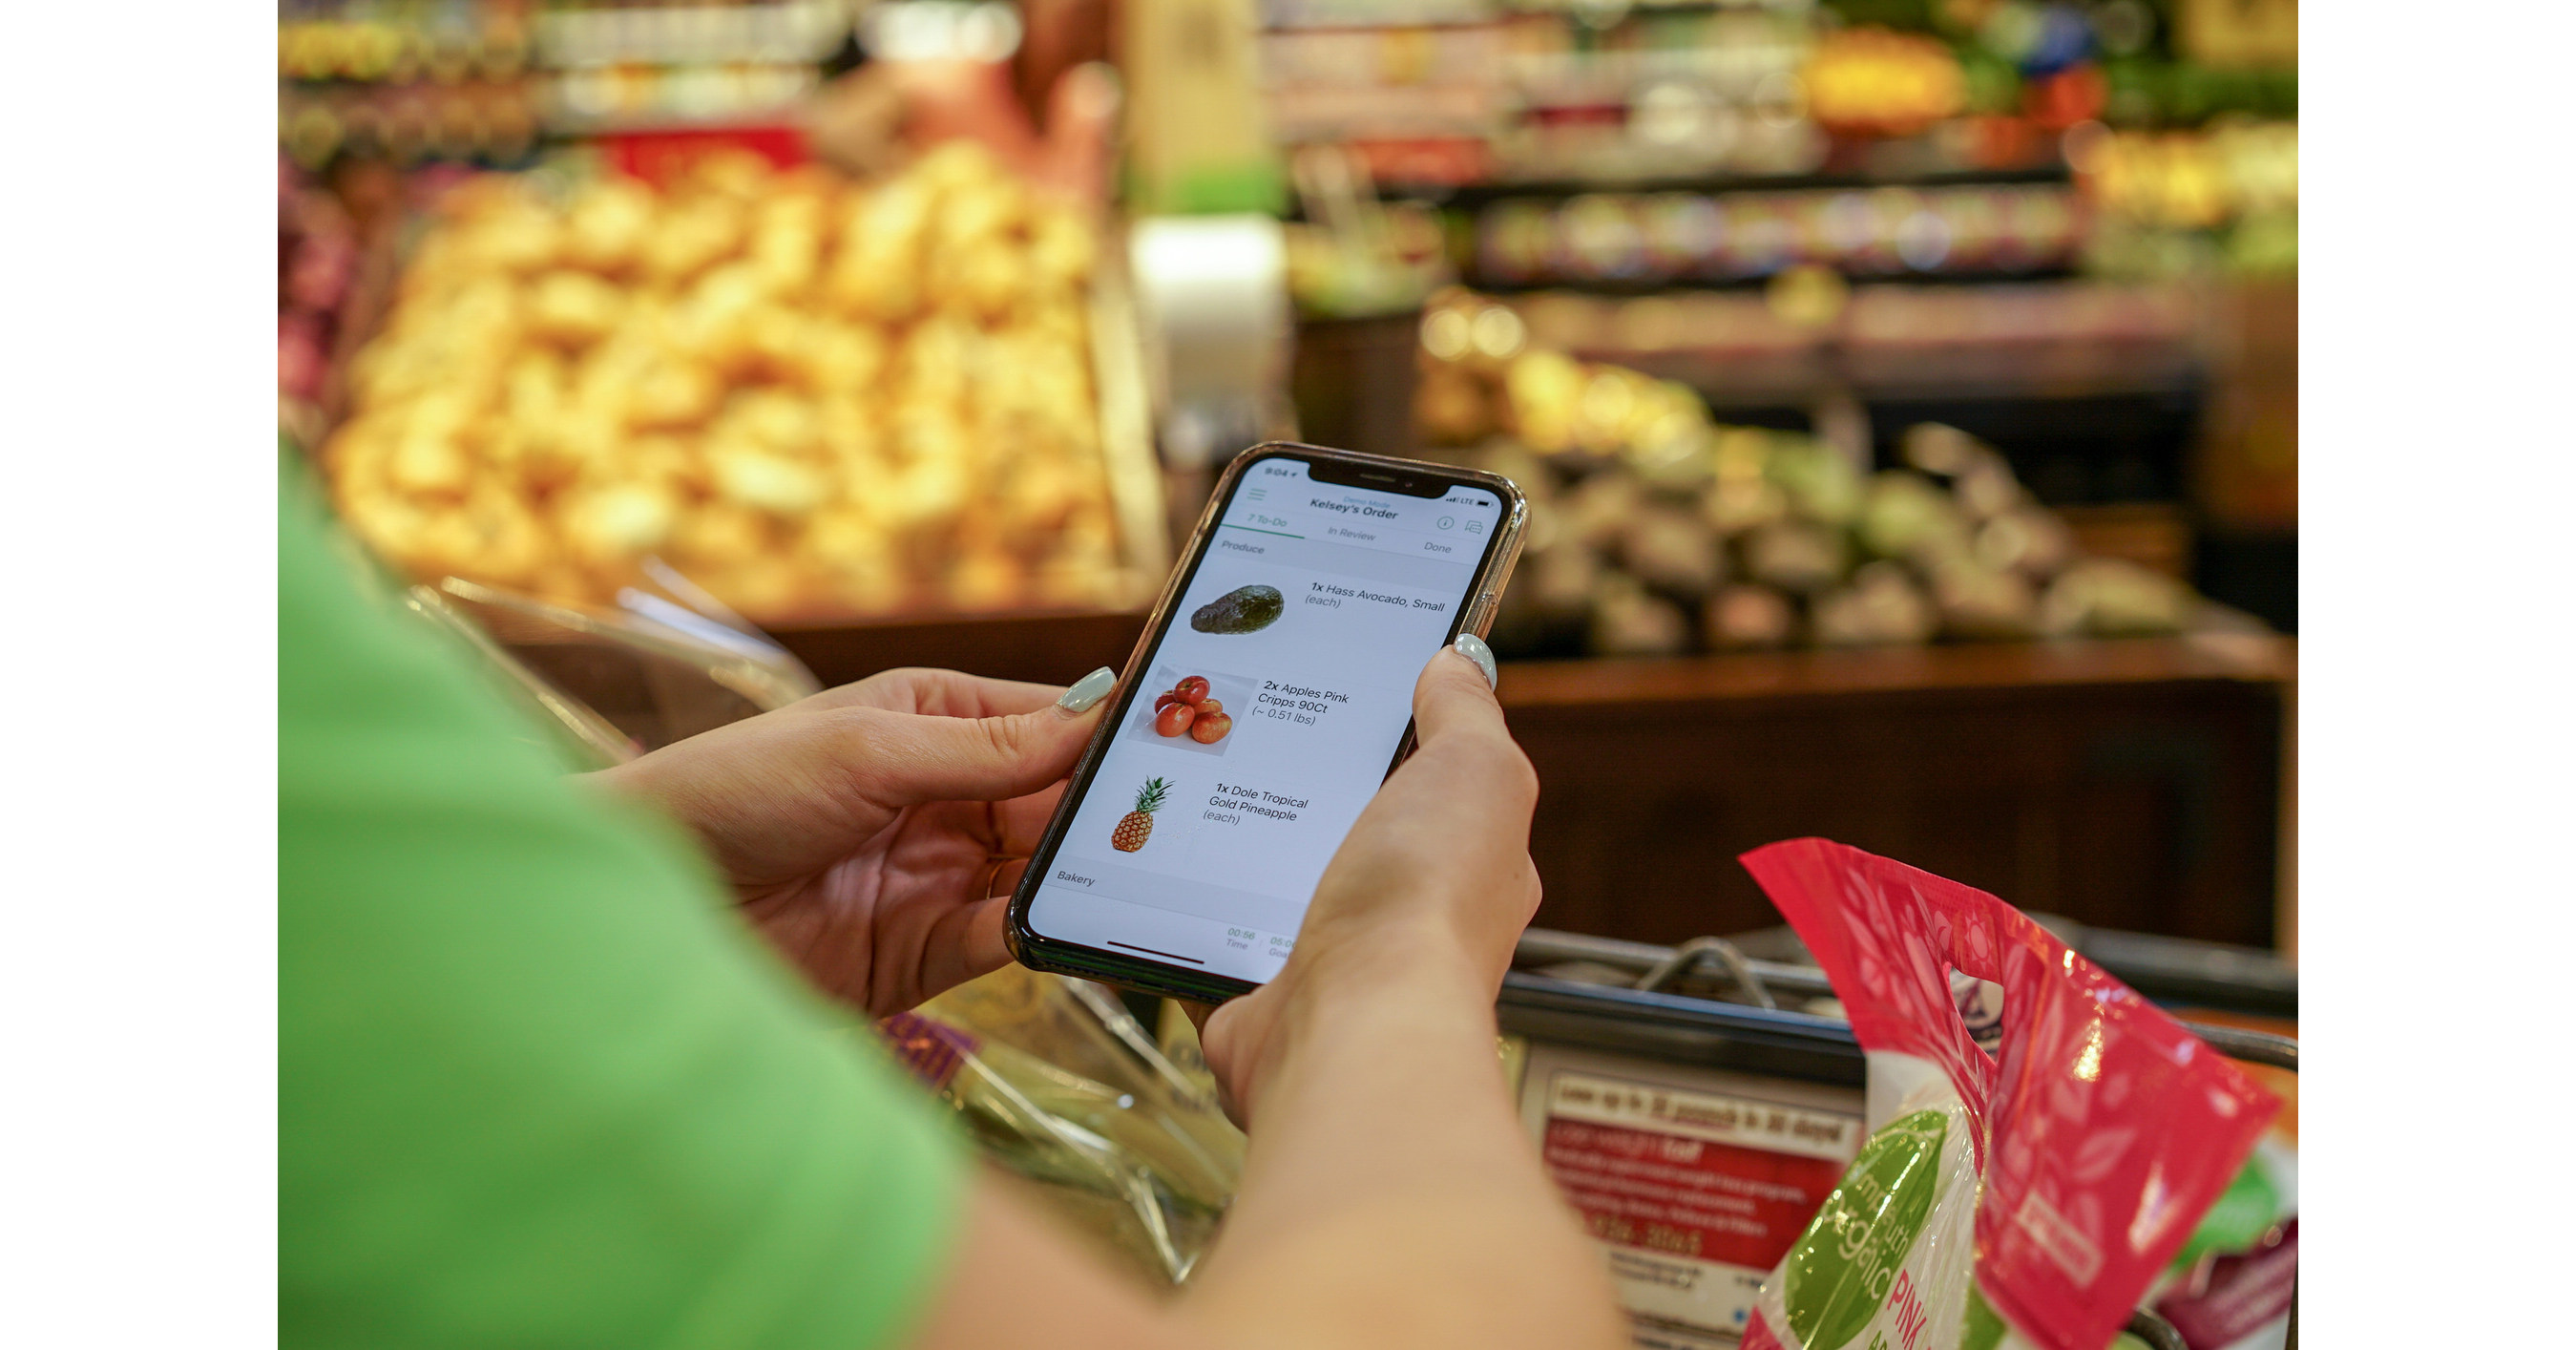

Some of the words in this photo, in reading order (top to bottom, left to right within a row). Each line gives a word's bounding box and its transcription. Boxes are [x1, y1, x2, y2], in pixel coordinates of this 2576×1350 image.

[1309, 497, 1360, 515] Kelsey's
[1362, 506, 1399, 520] Order
[1459, 496, 1476, 507] LTE
[1256, 514, 1288, 527] To-Do
[1328, 526, 1338, 536] In
[1339, 528, 1377, 541] Review
[1222, 539, 1266, 555] Produce
[1424, 541, 1452, 554] Done
[1305, 594, 1342, 610] (each)
[1310, 581, 1325, 593] 1x
[1326, 584, 1355, 599] Hass
[1356, 589, 1410, 608] Avocado,
[1412, 599, 1446, 613] Small
[1264, 679, 1280, 691] 2x
[1281, 684, 1322, 701] Apples
[1324, 690, 1350, 705] Pink
[1258, 693, 1296, 709] Cripps
[1298, 700, 1329, 714] 90Ct
[1267, 708, 1292, 722] 0.51
[1294, 712, 1316, 727] lbs)
[1216, 782, 1230, 793] 1x
[1231, 785, 1259, 799] Dole
[1262, 791, 1309, 810] Tropical
[1209, 796, 1237, 810] Gold
[1239, 803, 1298, 822] Pineapple
[1203, 810, 1241, 826] (each)
[1057, 871, 1096, 889] Bakery
[1227, 927, 1256, 940] 00:56
[1226, 939, 1248, 950] Time
[1887, 1268, 1927, 1350] PINK
